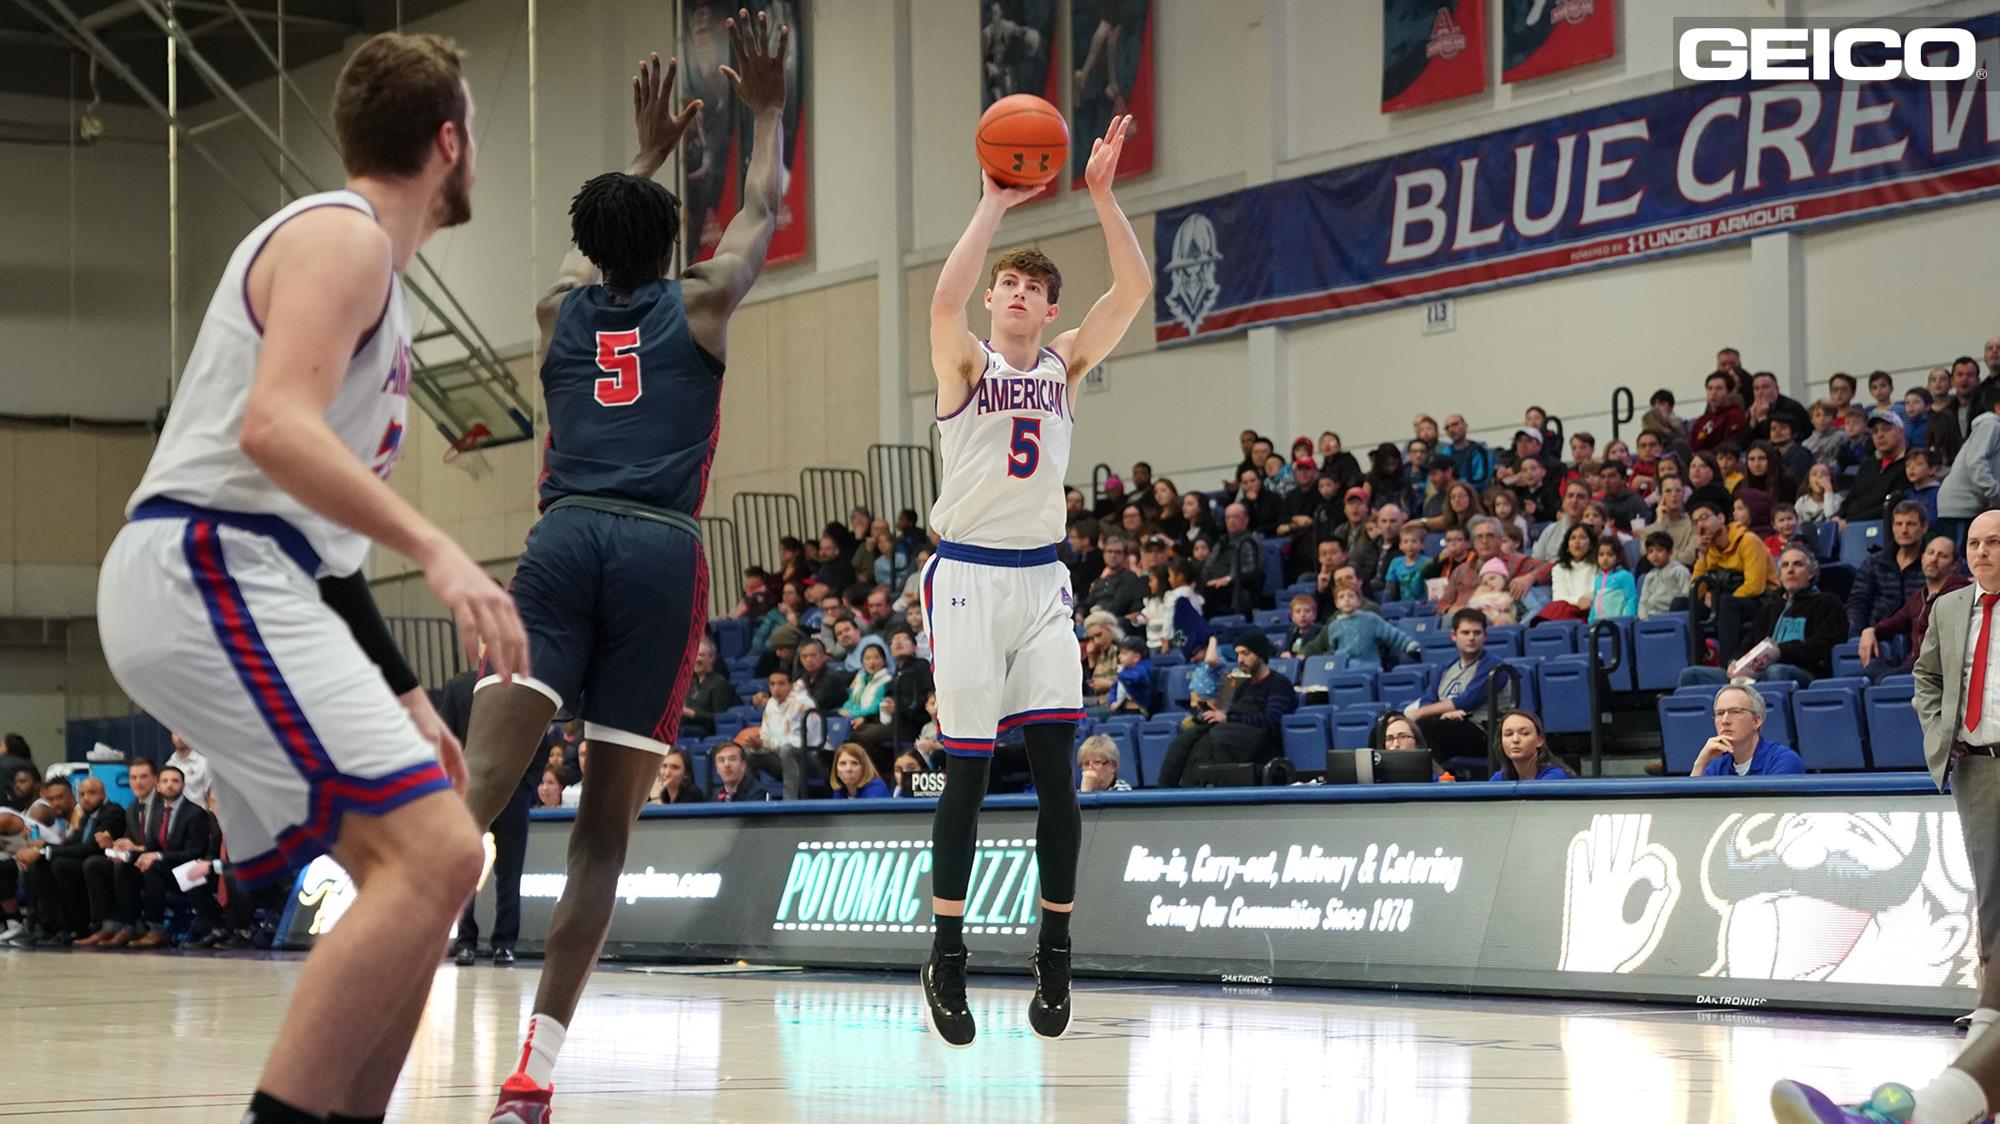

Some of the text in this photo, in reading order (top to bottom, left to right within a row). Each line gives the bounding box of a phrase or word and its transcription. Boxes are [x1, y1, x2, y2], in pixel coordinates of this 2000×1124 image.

[1385, 118, 1650, 265] BLUE
[1648, 223, 1712, 248] UNDER
[1716, 205, 1796, 235] ARMOUR
[594, 326, 643, 407] 5
[977, 377, 1065, 420] AMERICAN
[1007, 416, 1041, 479] 5
[911, 772, 945, 791] POSS
[775, 850, 932, 923] POTOMAC
[1357, 843, 1379, 883] &
[1379, 843, 1464, 893] Catering
[1322, 897, 1368, 930] Since
[1369, 898, 1414, 932] 1978
